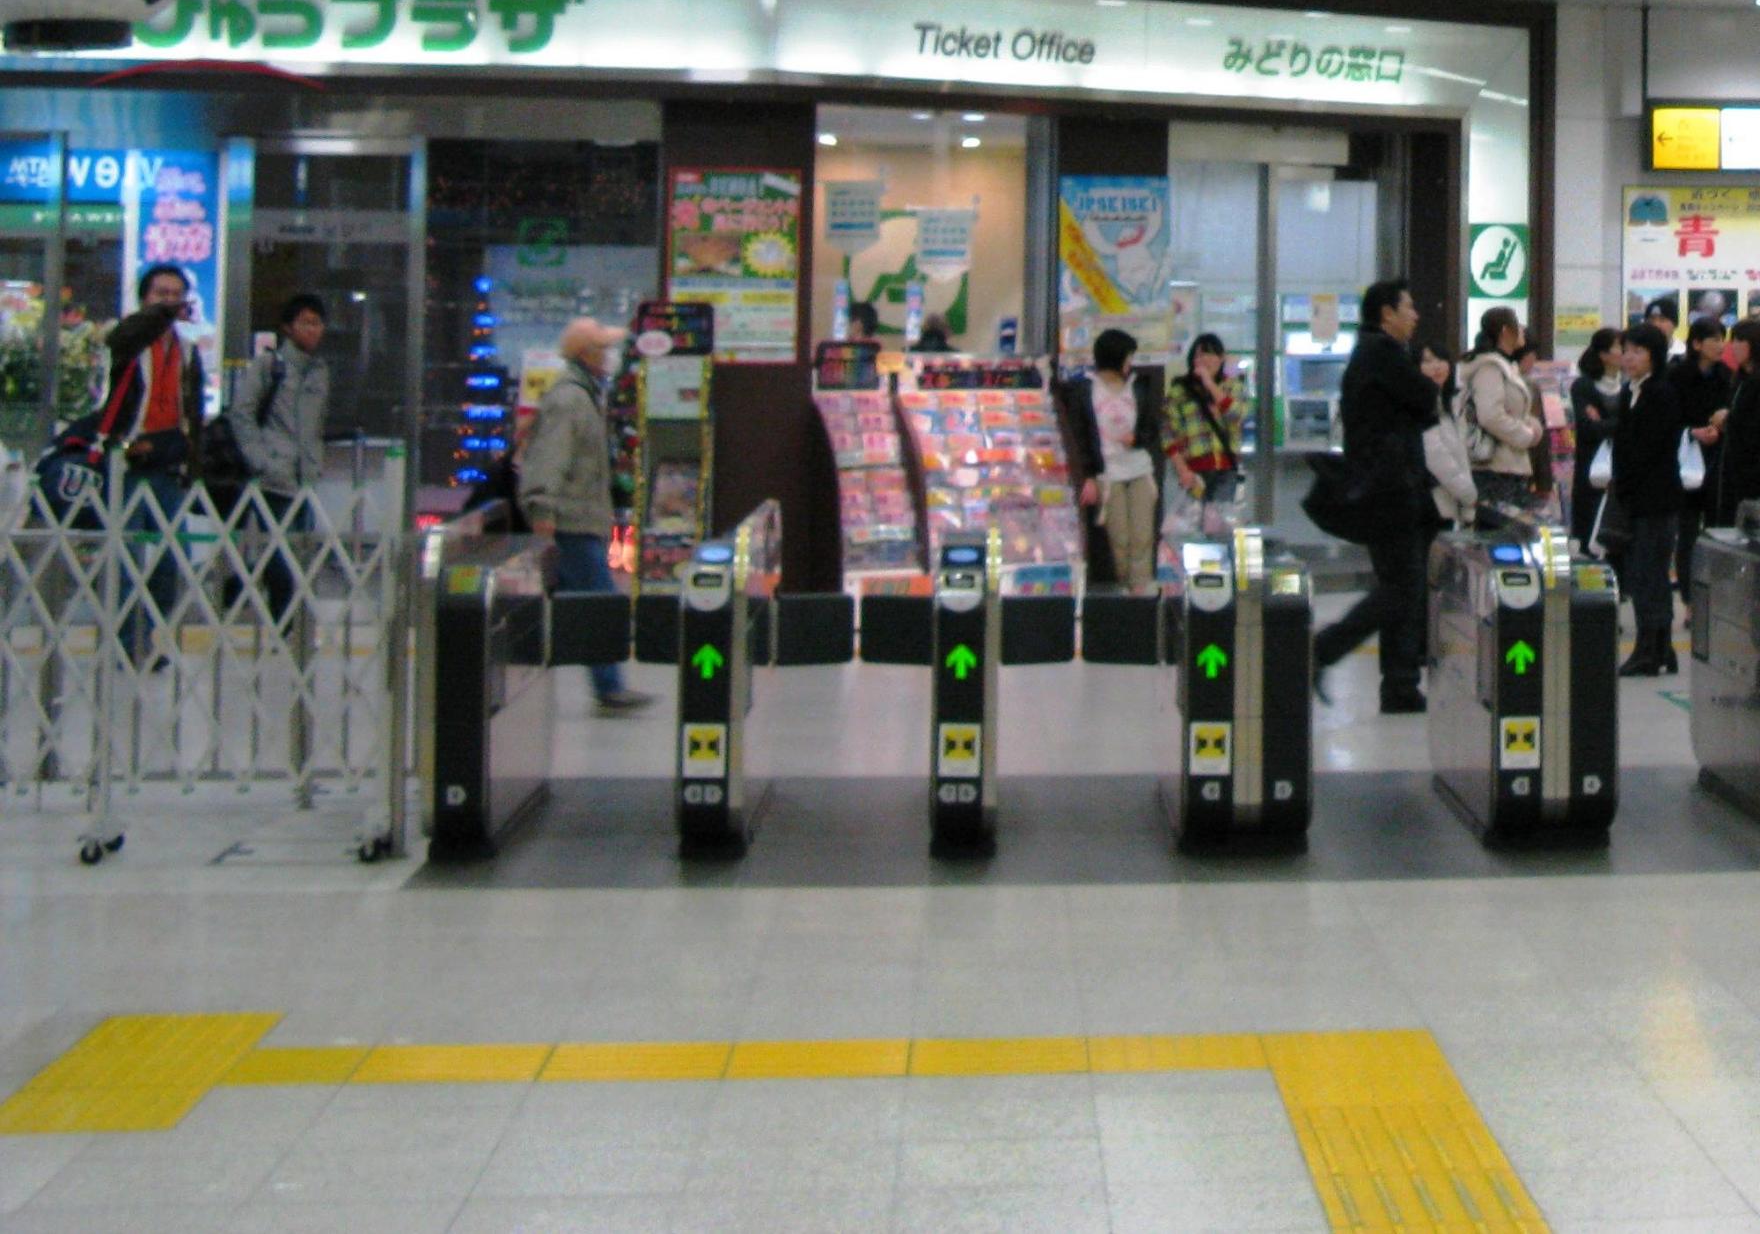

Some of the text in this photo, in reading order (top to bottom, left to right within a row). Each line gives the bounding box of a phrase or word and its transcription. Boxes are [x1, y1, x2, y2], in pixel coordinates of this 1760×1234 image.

[914, 22, 1096, 65] Ticket Office
[1223, 37, 1406, 83] みどりの窓口
